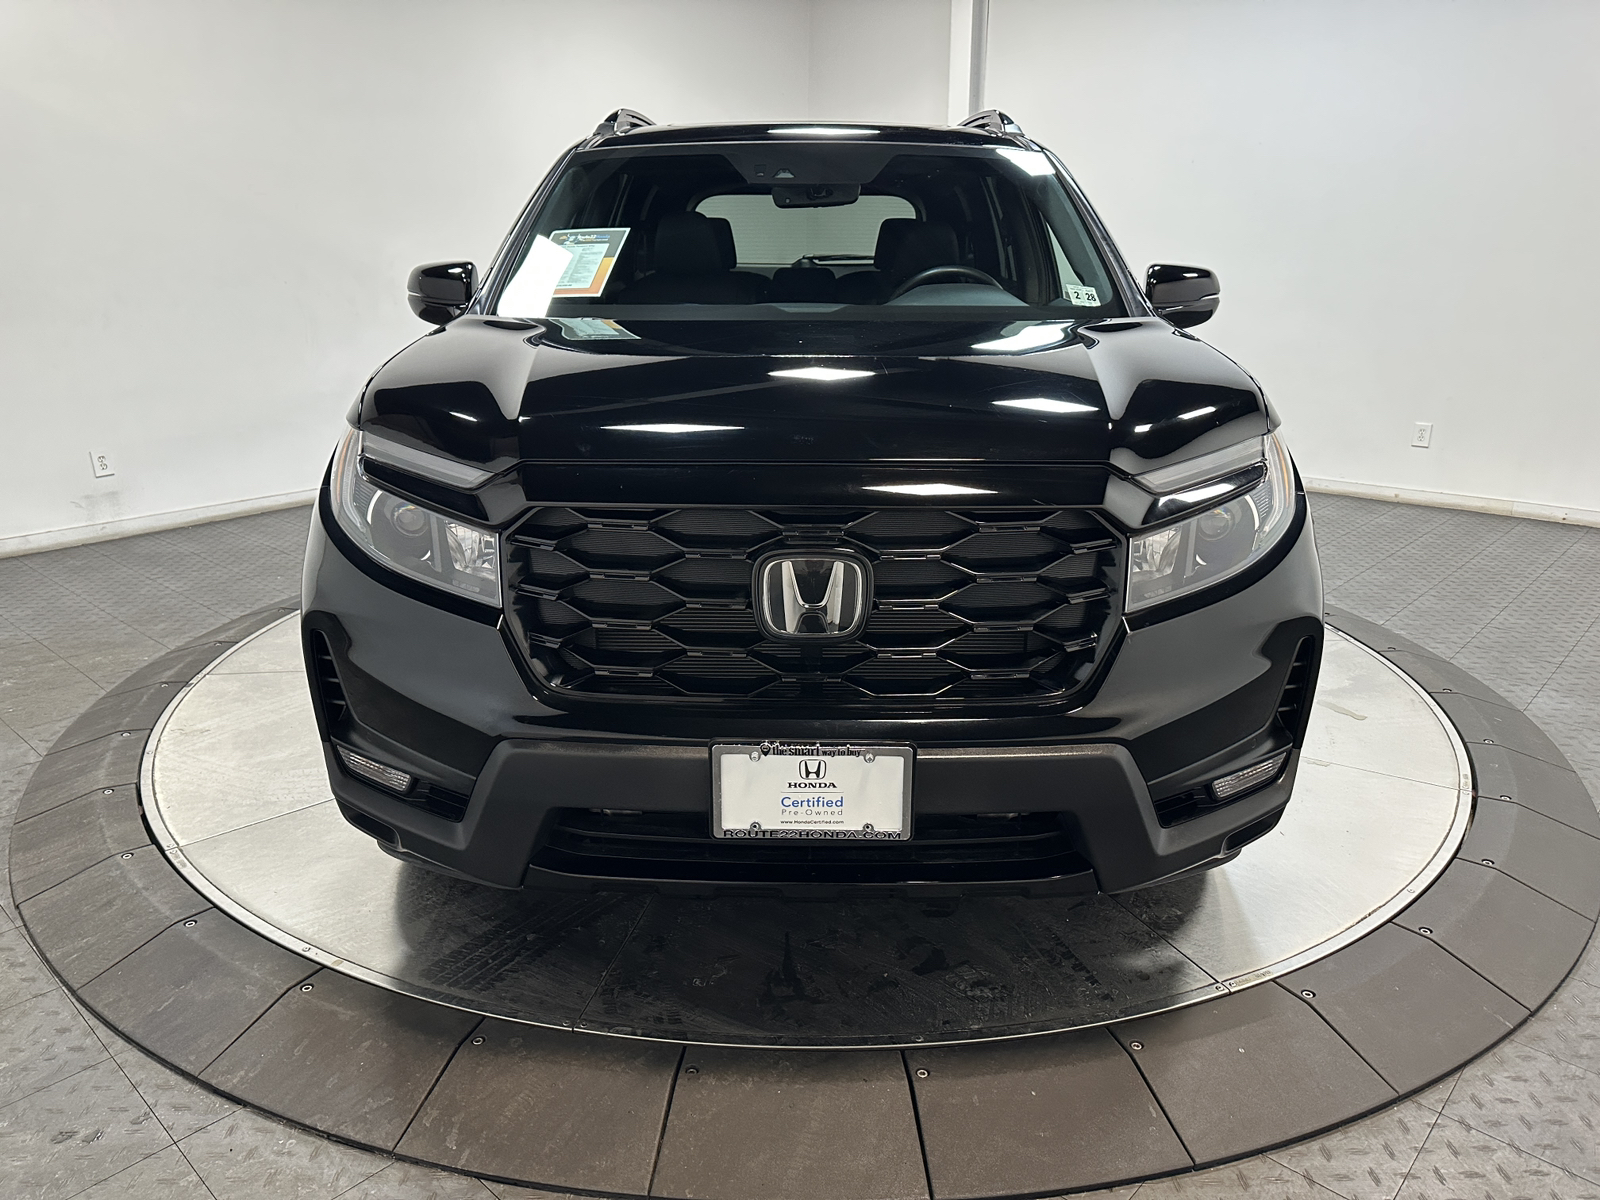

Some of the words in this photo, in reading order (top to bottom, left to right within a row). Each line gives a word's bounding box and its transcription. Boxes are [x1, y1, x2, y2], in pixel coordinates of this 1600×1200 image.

[1074, 291, 1081, 299] 2
[1085, 293, 1096, 301] 28
[772, 745, 787, 756] the
[788, 744, 820, 756] smart
[837, 747, 846, 756] to
[847, 745, 861, 757] buy
[781, 796, 844, 808] Certified
[781, 808, 843, 816] Pre-Owned
[723, 829, 902, 840] ROUTE22HONDA.COM
